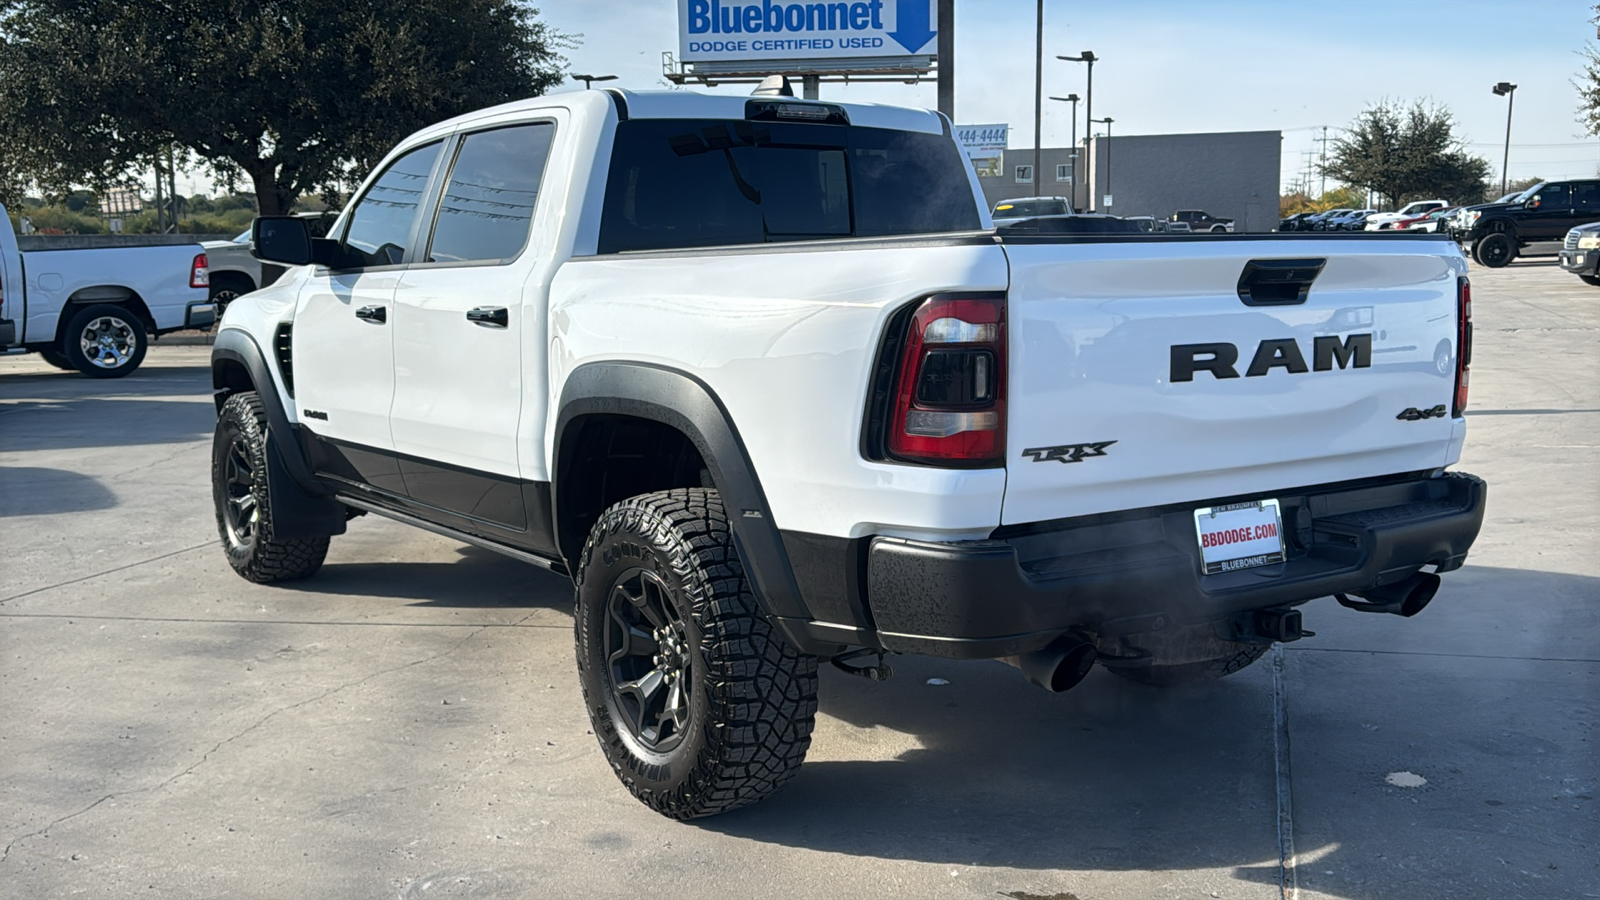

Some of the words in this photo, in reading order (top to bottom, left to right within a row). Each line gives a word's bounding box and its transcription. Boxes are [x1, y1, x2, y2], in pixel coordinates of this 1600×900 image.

[687, 0, 883, 34] Bluebonnet
[689, 41, 748, 53] DODGE
[751, 38, 834, 51] CERTIFIED
[840, 37, 884, 49] USED
[1170, 333, 1372, 383] RAM
[1021, 440, 1118, 464] TRX
[1201, 523, 1277, 548] BBDODGE.COM
[1221, 555, 1268, 571] BLUEBONNET
